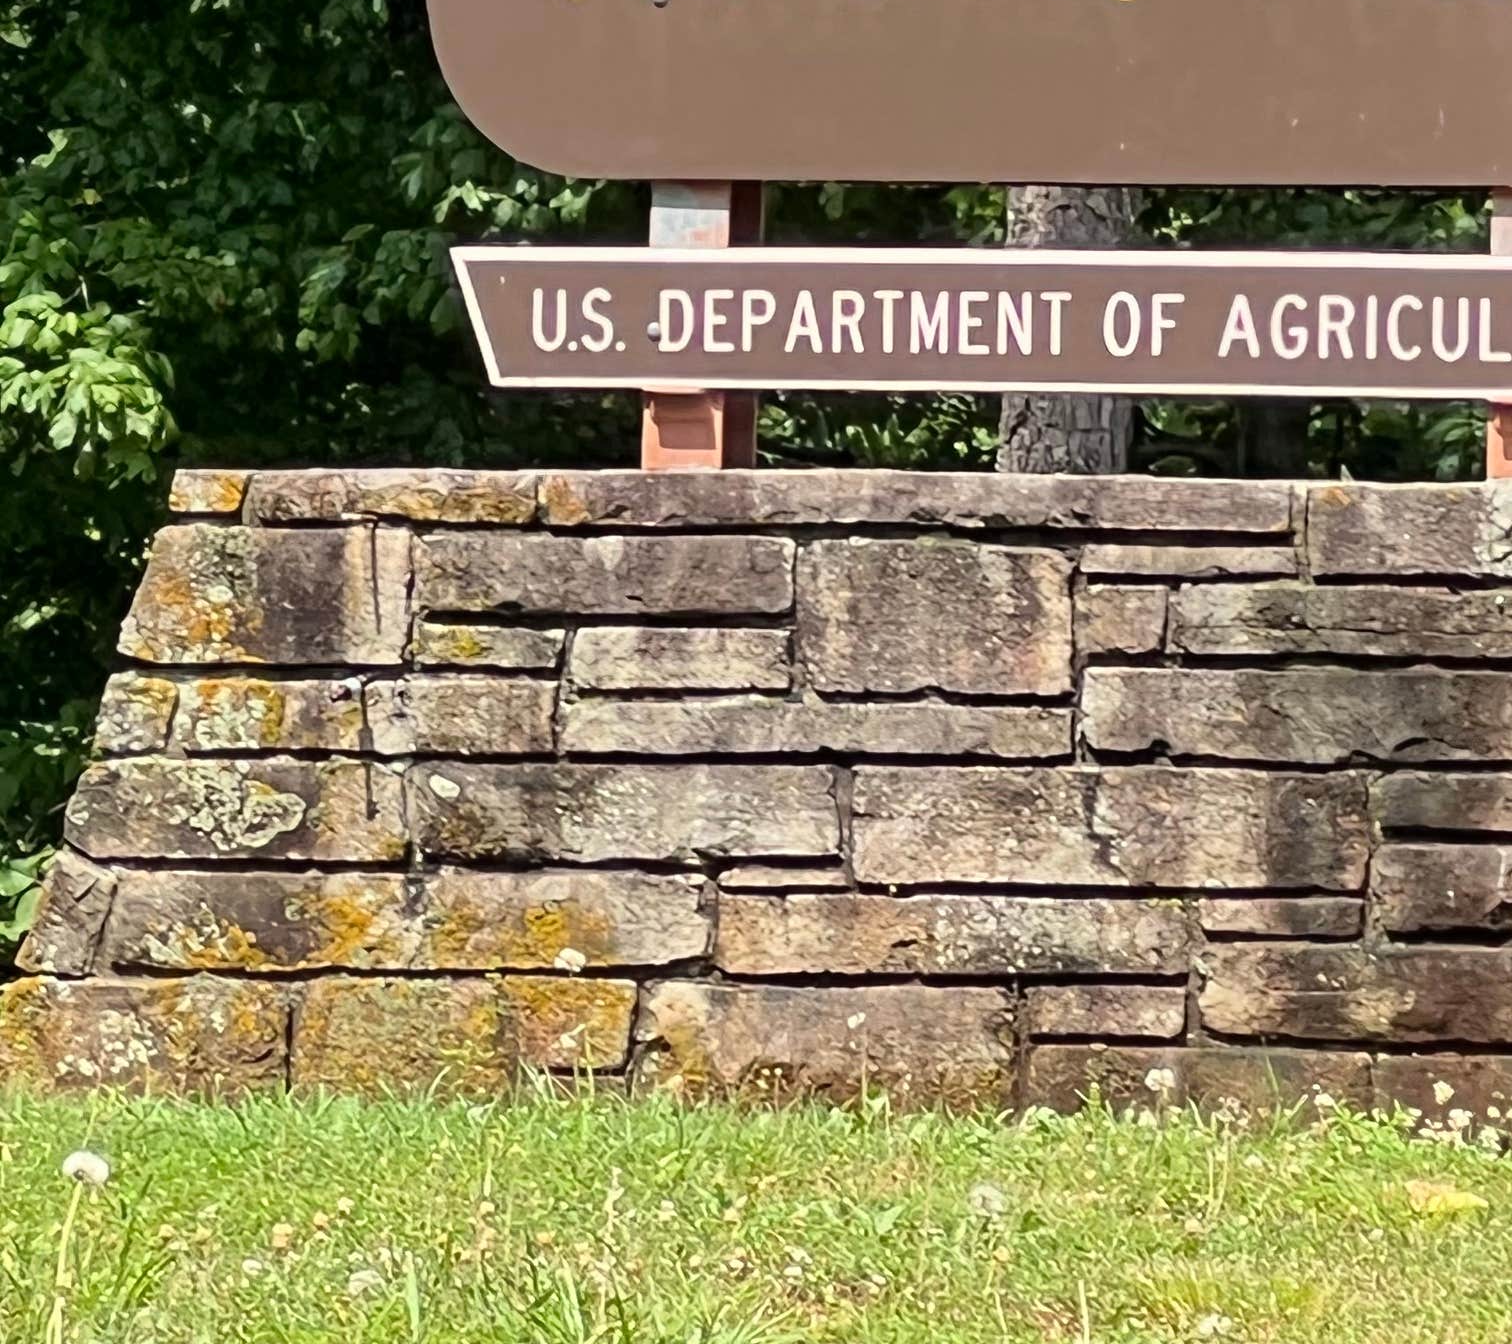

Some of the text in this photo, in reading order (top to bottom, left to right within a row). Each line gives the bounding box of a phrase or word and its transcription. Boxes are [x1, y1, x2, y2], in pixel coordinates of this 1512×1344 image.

[532, 287, 626, 353] U.S.
[658, 289, 1073, 356] DEPARTMENT
[1103, 290, 1186, 357] OF
